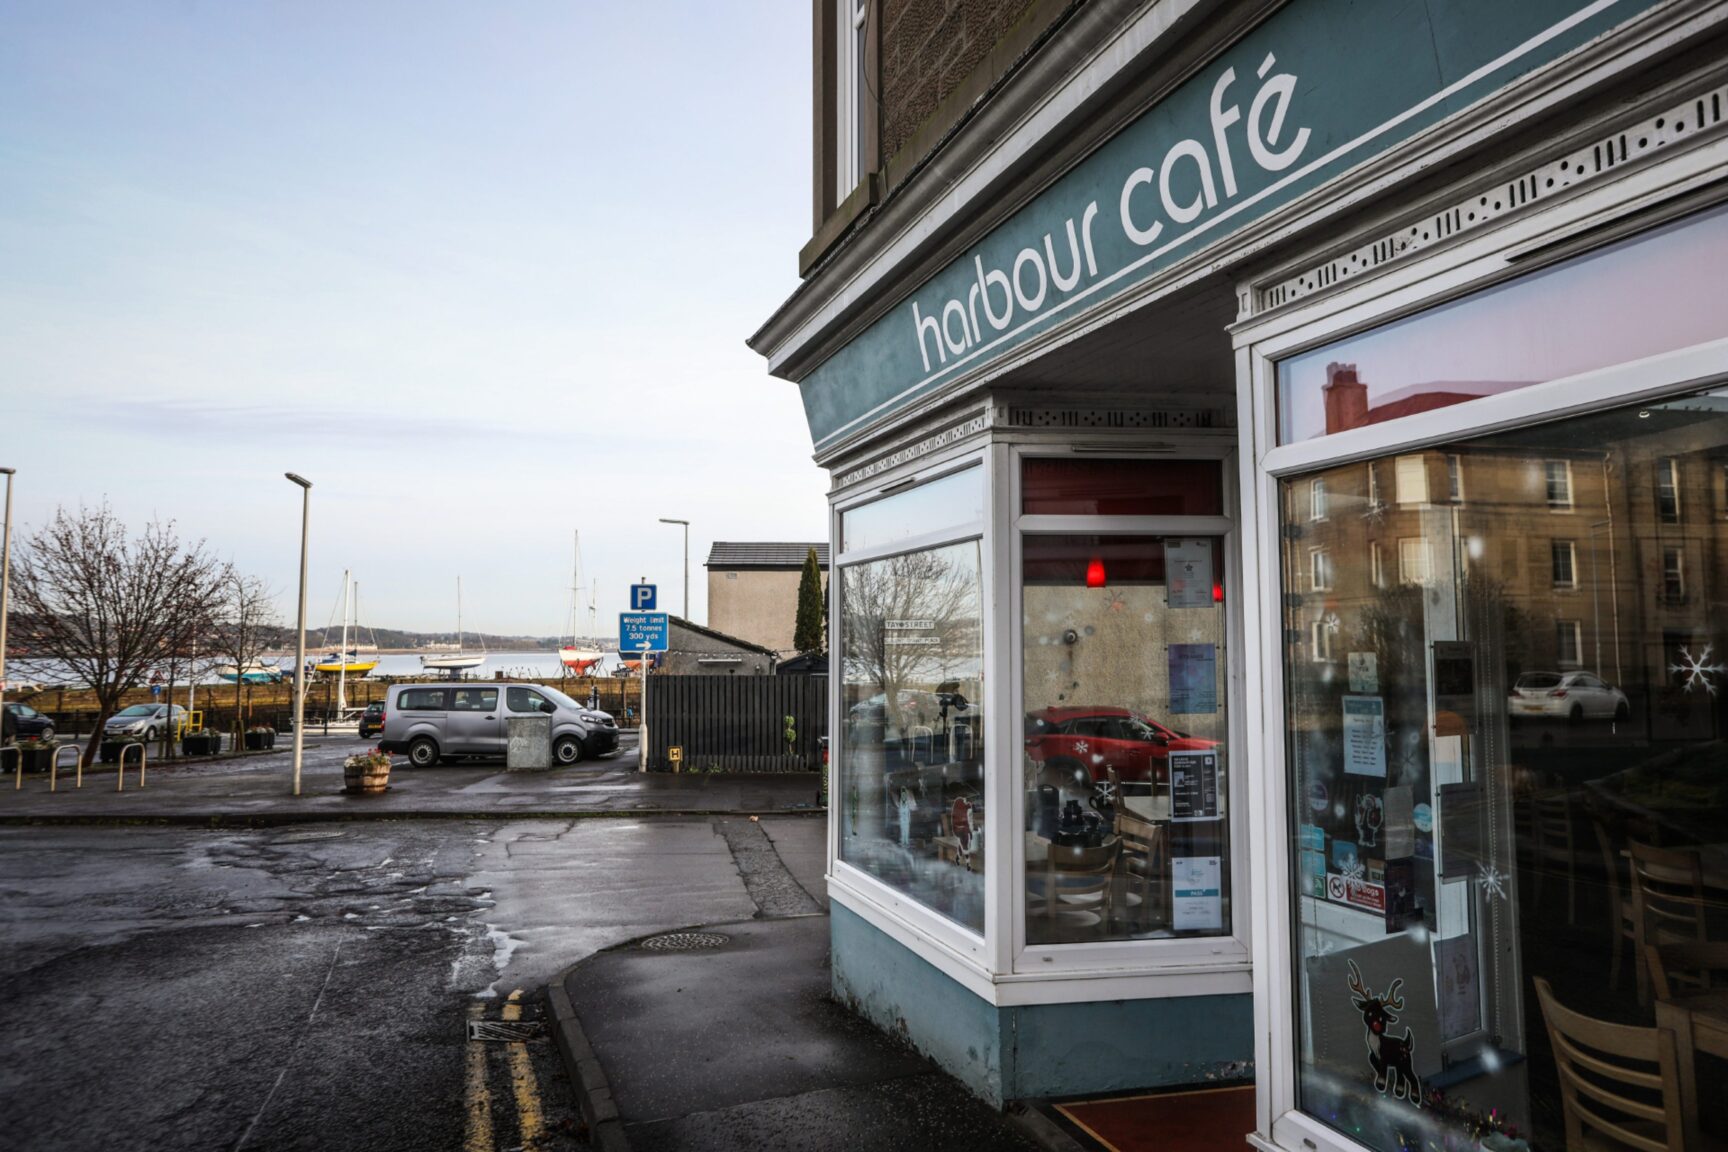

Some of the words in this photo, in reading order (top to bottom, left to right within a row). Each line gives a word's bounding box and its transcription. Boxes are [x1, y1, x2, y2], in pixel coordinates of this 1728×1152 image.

[912, 201, 1098, 372] harbour
[1120, 51, 1312, 246] café
[637, 587, 652, 608] P
[623, 616, 647, 624] Weight
[629, 632, 644, 640] 300
[645, 633, 658, 641] yds
[671, 749, 679, 758] H
